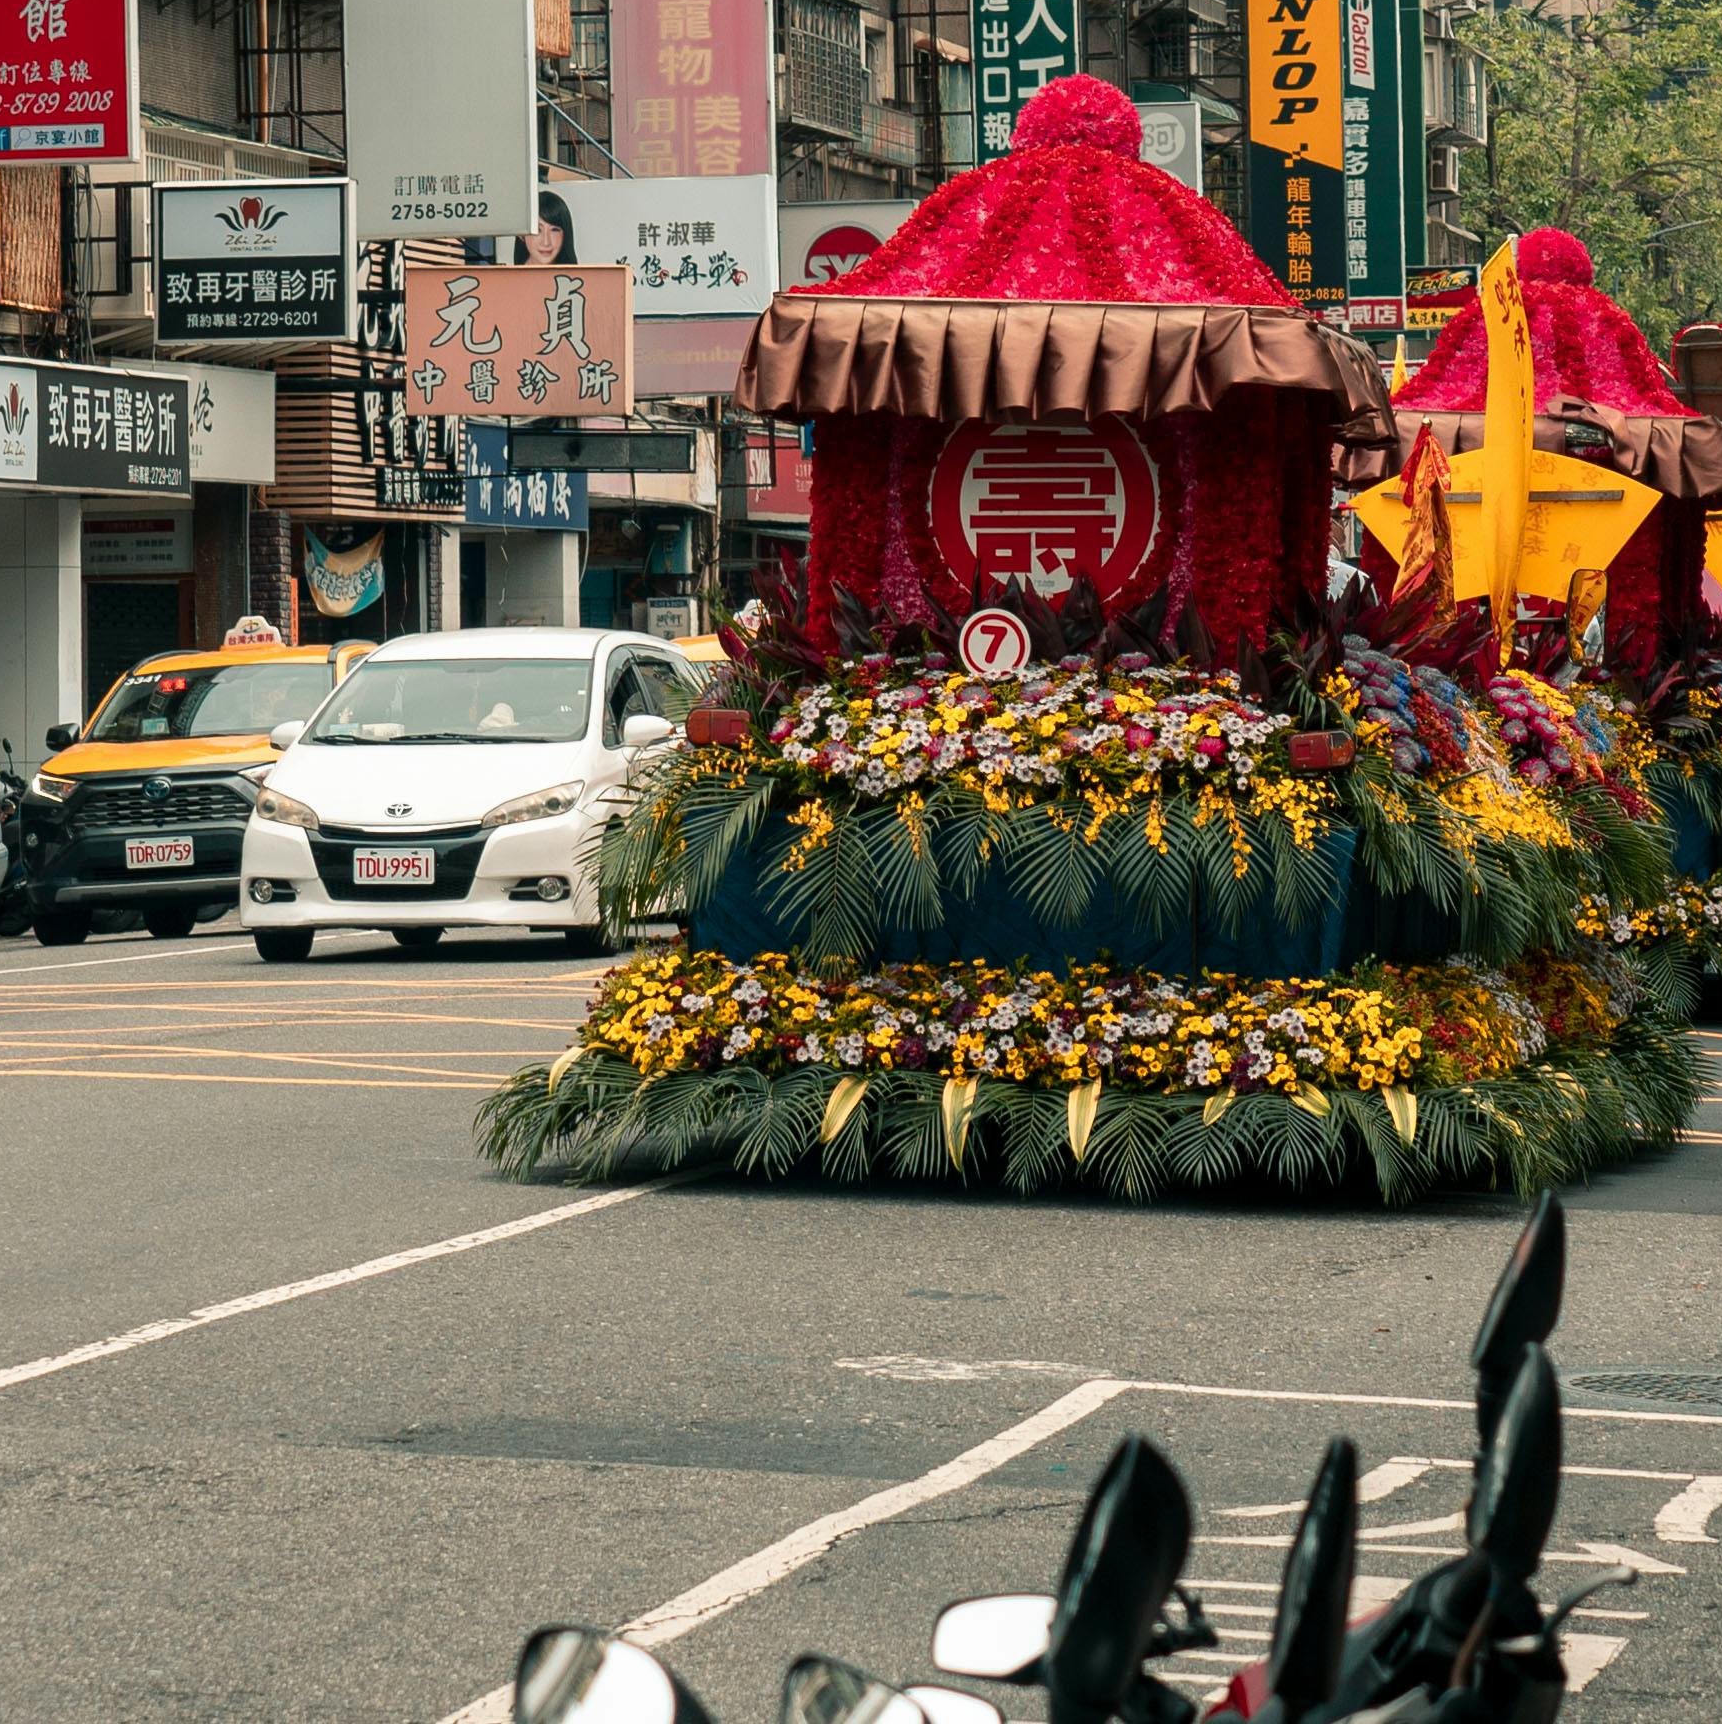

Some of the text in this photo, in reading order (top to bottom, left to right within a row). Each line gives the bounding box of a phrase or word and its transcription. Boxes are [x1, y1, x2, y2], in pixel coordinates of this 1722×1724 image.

[1351, 12, 1370, 76] Castrol
[64, 90, 114, 112] 2008
[35, 128, 100, 145] 京宴小館
[632, 97, 677, 176] 用品
[693, 95, 742, 176] 美容
[394, 173, 485, 197] 訂購電話
[391, 202, 489, 221] 2758-5022
[1286, 177, 1312, 284] 龍年輪胎
[638, 220, 715, 247] 許淑華
[166, 268, 337, 304] 致再牙醫診所
[616, 250, 741, 288] 您再戰
[805, 253, 870, 285] SY
[430, 274, 592, 360] 元貞
[411, 359, 620, 406] 中醫診所
[48, 382, 177, 456] 致再牙醫診所
[228, 633, 275, 646] 台灣大車隊
[980, 624, 1008, 664] 7
